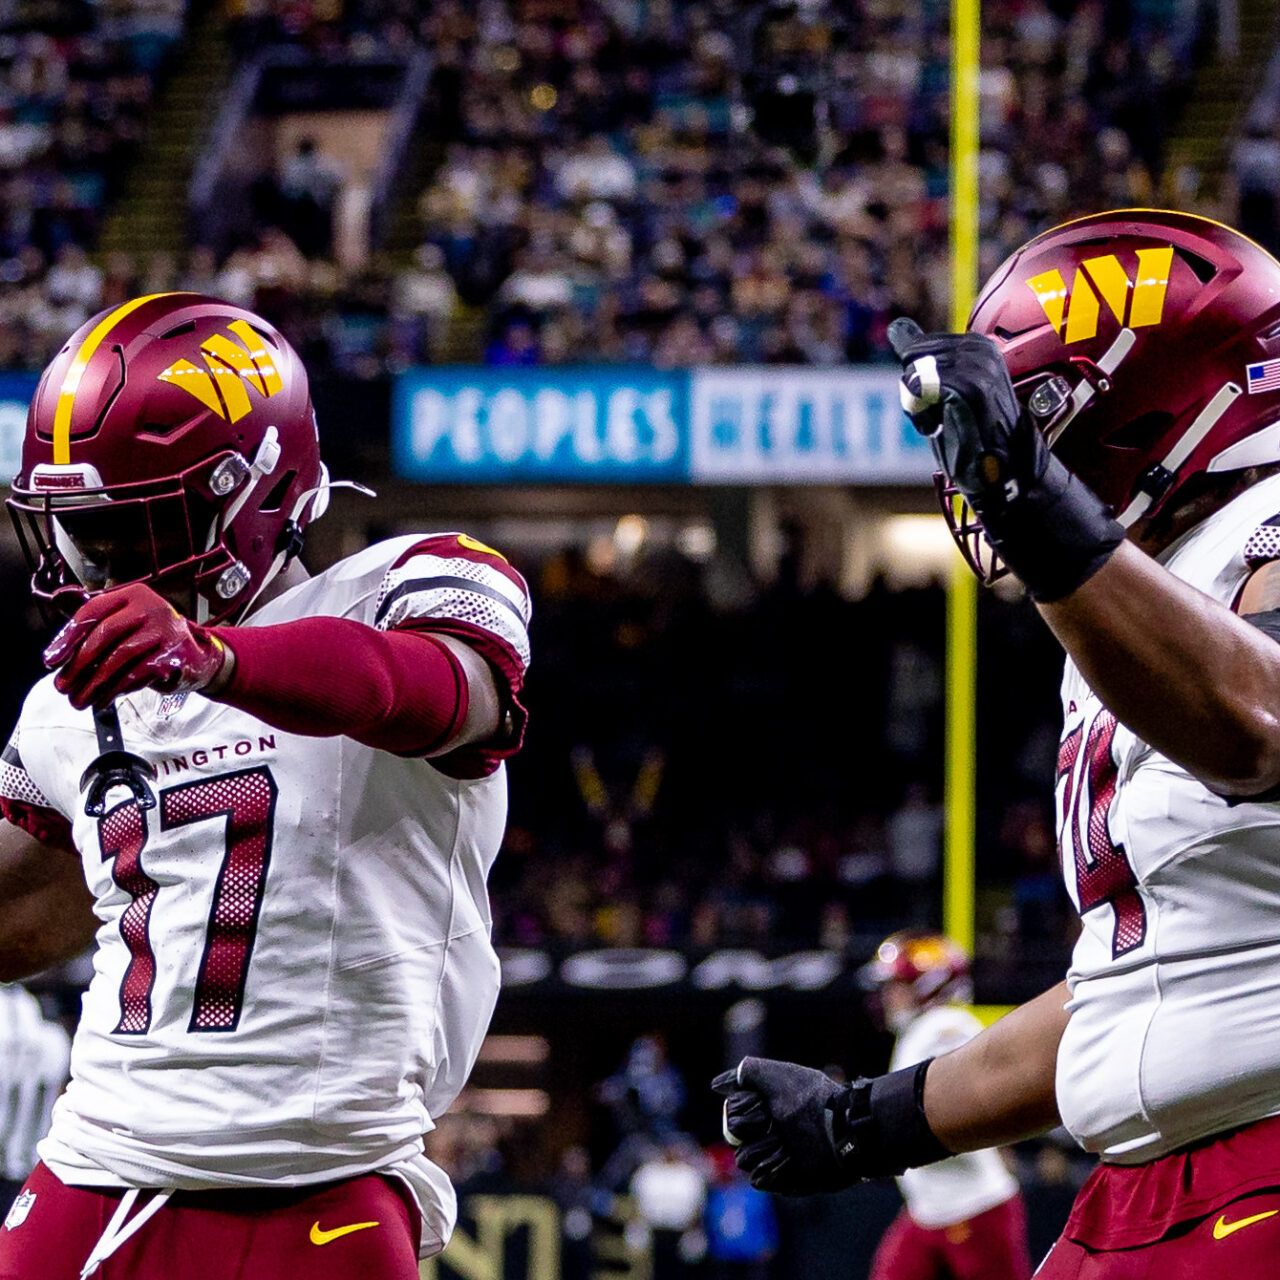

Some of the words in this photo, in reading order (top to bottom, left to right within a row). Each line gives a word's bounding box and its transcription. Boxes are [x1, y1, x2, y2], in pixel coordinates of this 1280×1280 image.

[410, 386, 680, 464] PEOPLES
[151, 735, 277, 777] INGTON
[97, 765, 279, 1035] 17
